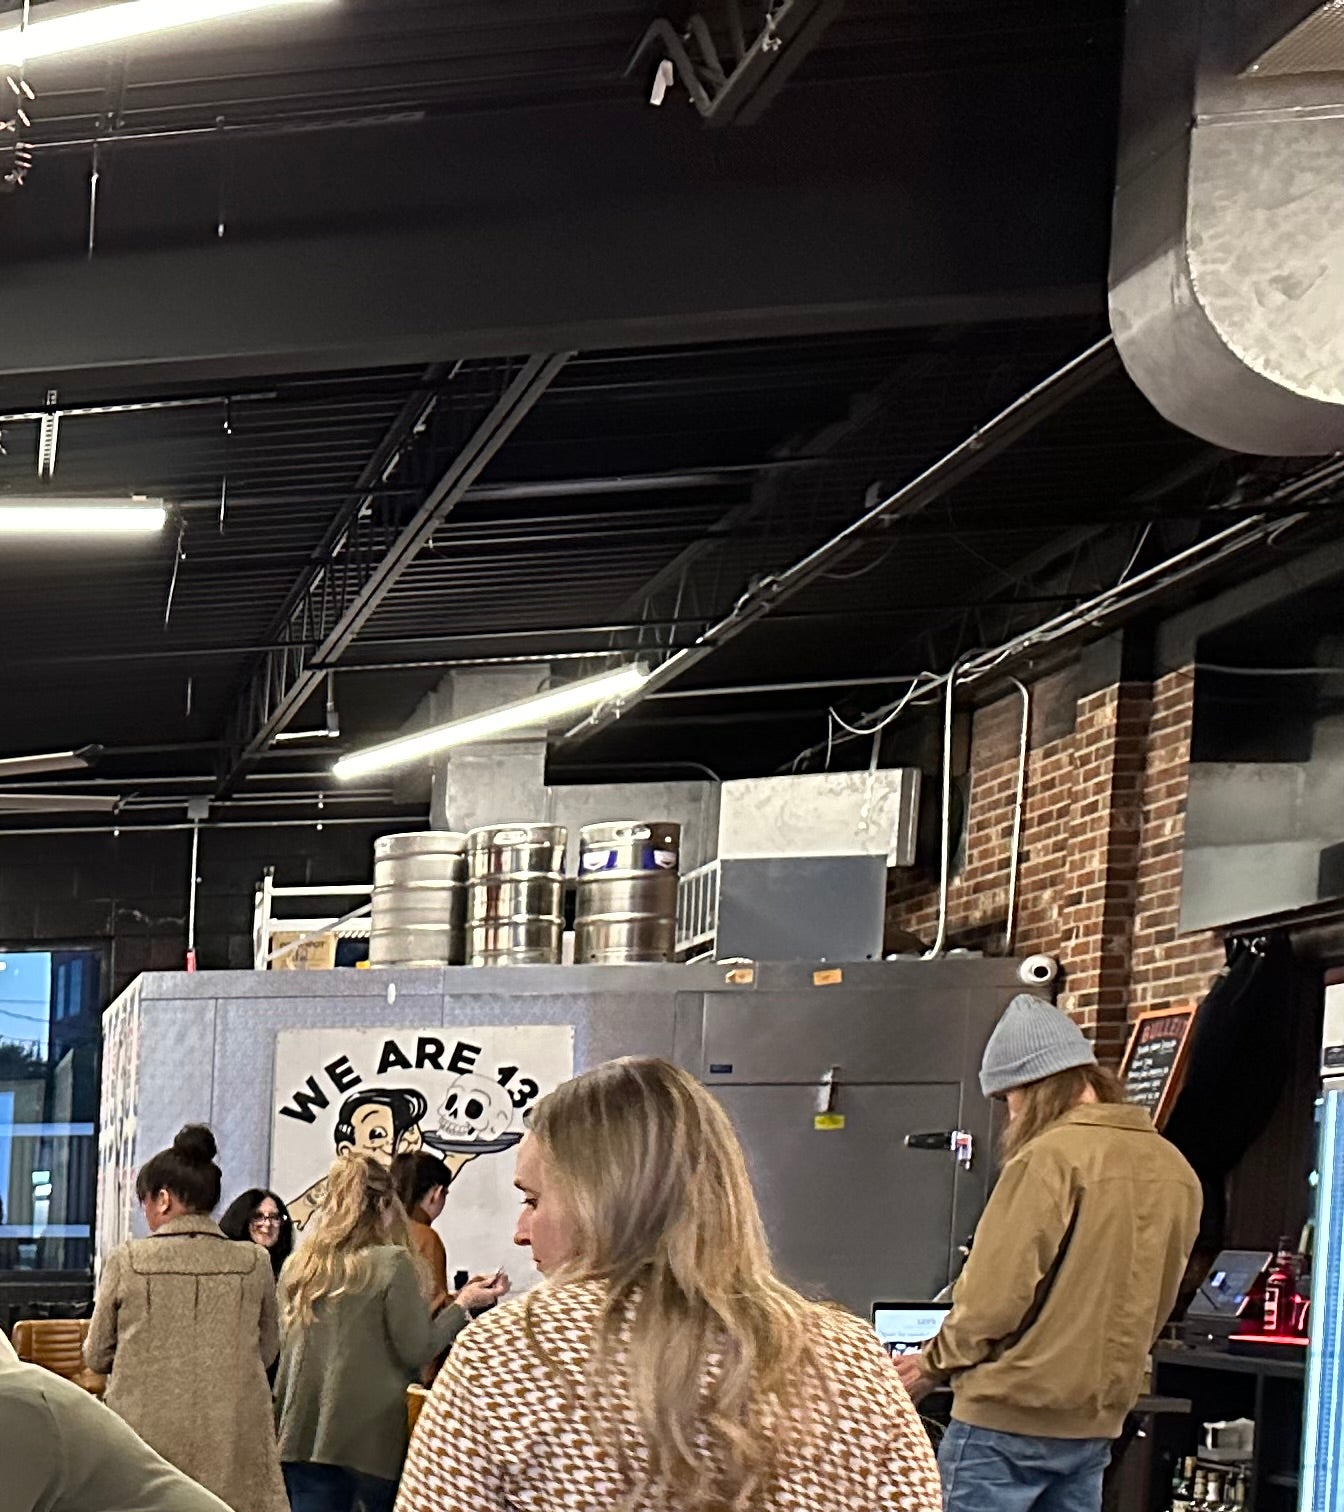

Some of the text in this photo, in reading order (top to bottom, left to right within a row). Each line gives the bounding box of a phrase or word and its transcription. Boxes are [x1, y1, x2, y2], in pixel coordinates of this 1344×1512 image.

[279, 1036, 540, 1124] WE ARE 13
